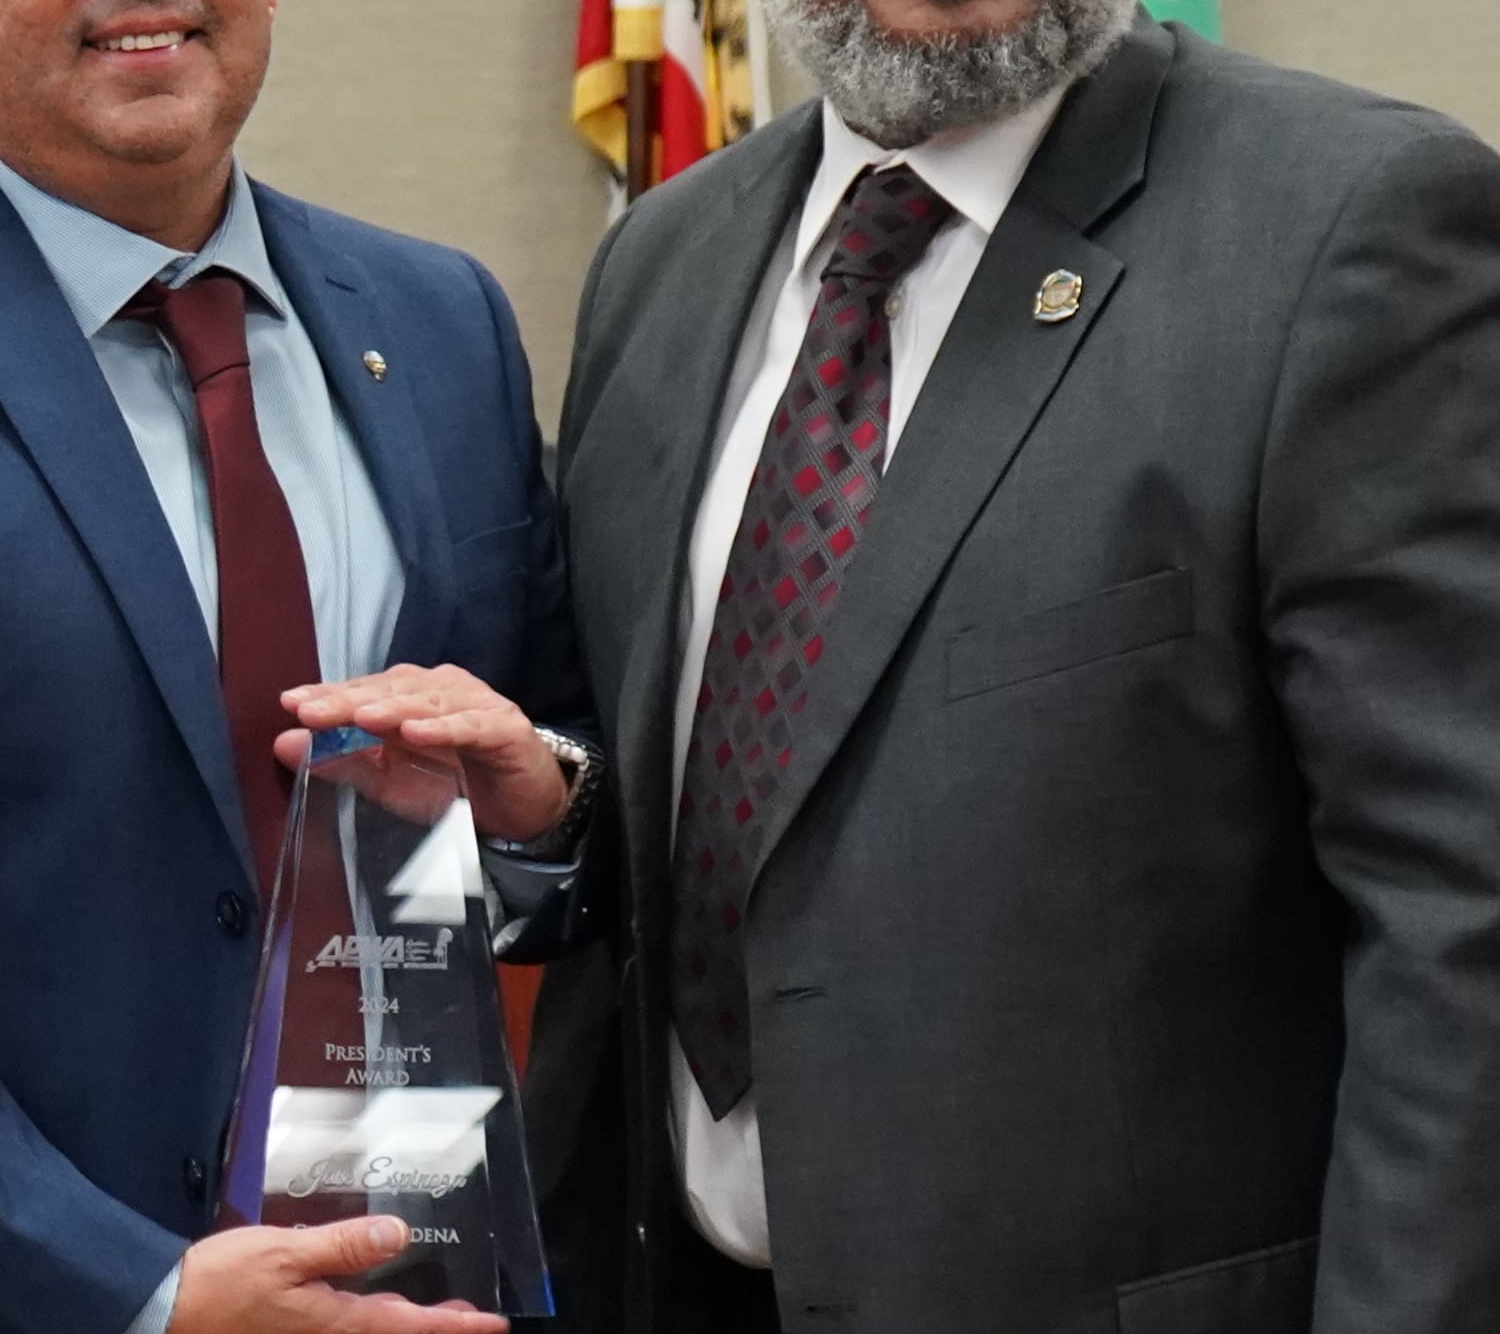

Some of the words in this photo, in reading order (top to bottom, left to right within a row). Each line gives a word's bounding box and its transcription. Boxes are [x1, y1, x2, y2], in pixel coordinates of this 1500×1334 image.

[358, 997, 399, 1014] 2024
[345, 1068, 410, 1086] AWARD
[410, 1228, 461, 1244] DENA
